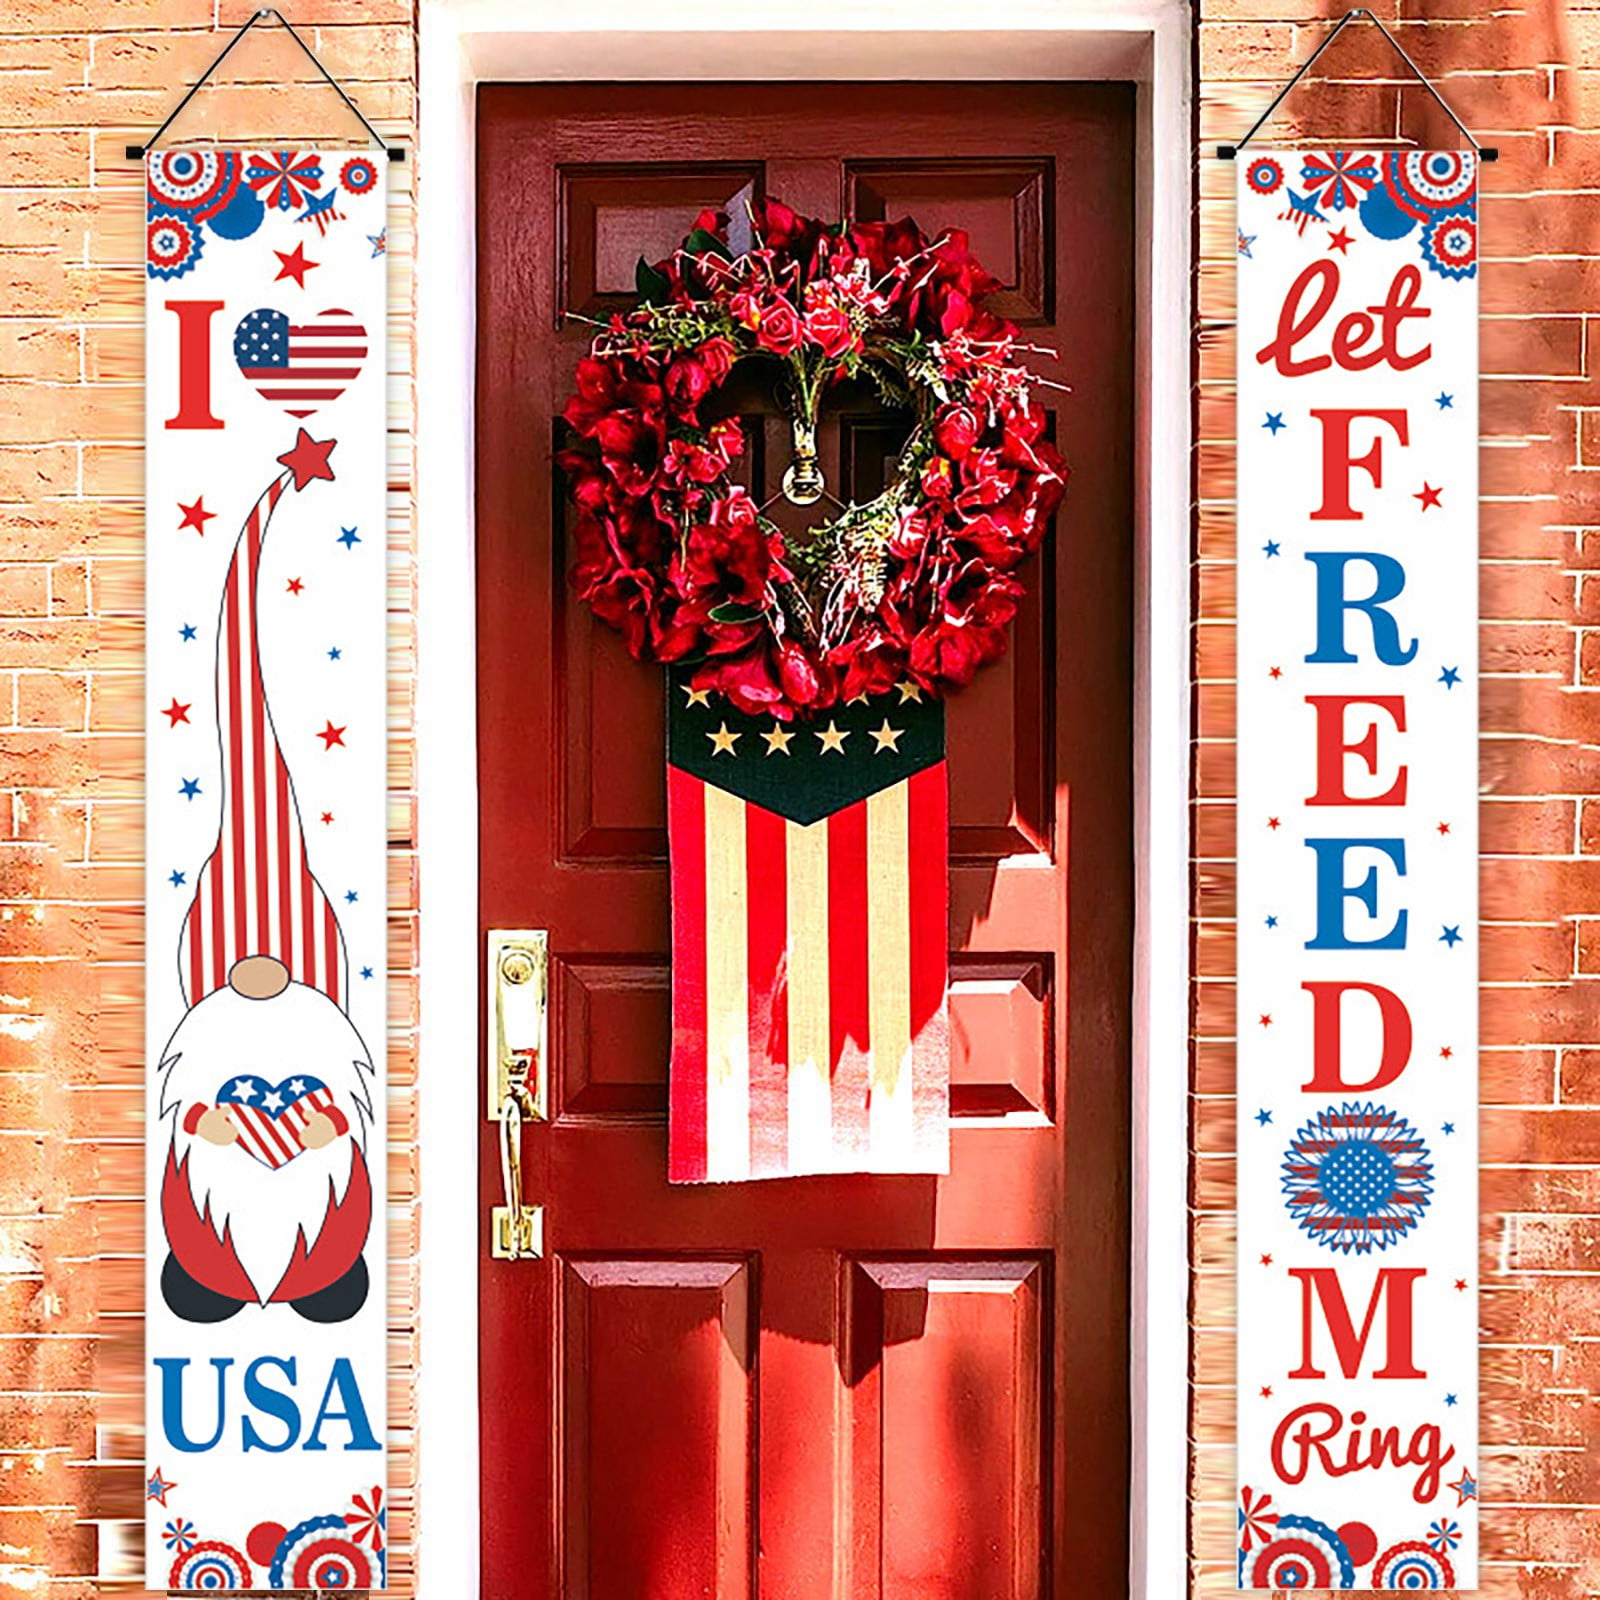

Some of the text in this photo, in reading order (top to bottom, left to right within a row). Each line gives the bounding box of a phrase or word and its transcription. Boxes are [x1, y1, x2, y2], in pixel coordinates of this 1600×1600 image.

[164, 300, 225, 430] I
[1256, 259, 1431, 377] let
[153, 1355, 382, 1453] USA
[1270, 1402, 1455, 1504] Ring
